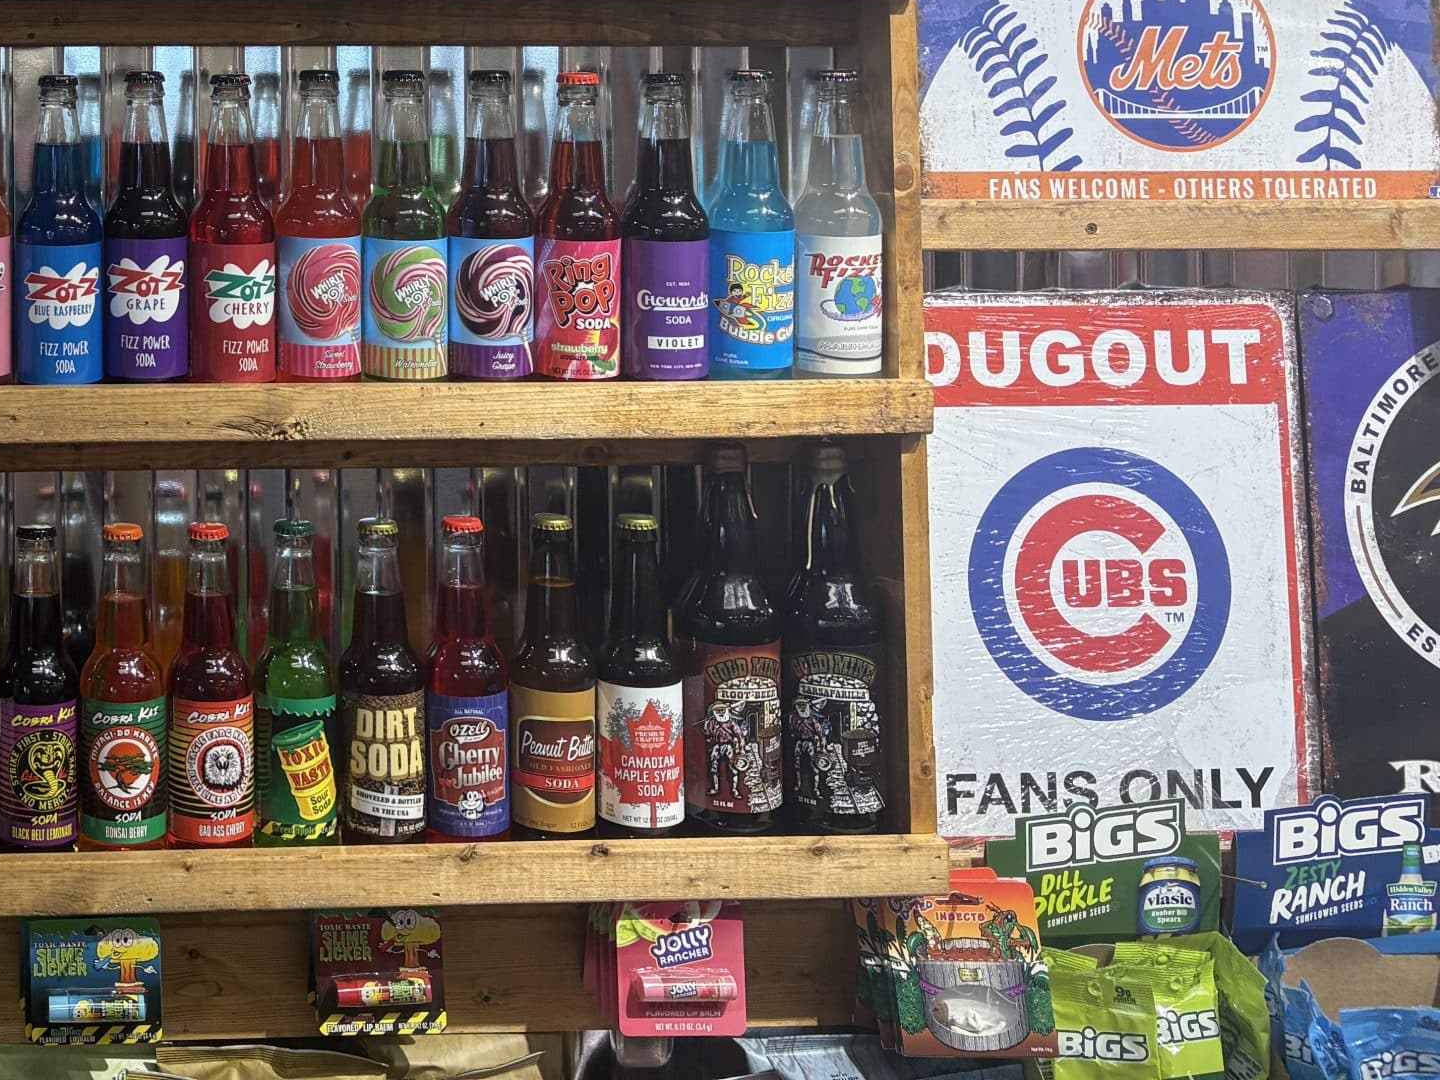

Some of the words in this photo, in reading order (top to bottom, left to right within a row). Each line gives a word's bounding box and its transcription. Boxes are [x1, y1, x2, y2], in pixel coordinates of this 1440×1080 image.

[1110, 26, 1243, 90] Mets
[989, 177, 1041, 200] FANS
[1049, 177, 1150, 200] WELCOME
[1174, 177, 1254, 199] OTHERS
[1263, 177, 1377, 199] TOLERATED
[542, 253, 611, 292] Ring
[310, 270, 344, 299] WHIRLY
[35, 305, 50, 315] BLUE
[54, 304, 92, 316] RASPBERRY
[127, 298, 165, 310] GRAPE
[224, 303, 269, 314] CHERRY
[576, 319, 611, 331] SODA
[665, 315, 692, 325] SODA
[720, 319, 772, 344] Bubble
[551, 343, 608, 355] strawberry
[656, 338, 701, 348] VIOLET
[395, 359, 438, 368] Watermelon
[923, 329, 1260, 387] DUGOUT
[1350, 352, 1440, 494] BALTIMORE
[283, 739, 326, 767] TOXIC
[522, 731, 563, 756] Peanut
[439, 742, 500, 769] Cherry
[621, 756, 674, 768] CANADIAN
[290, 758, 331, 788] WASTE
[454, 765, 502, 789] Jubilee
[545, 778, 580, 788] SODA
[615, 769, 651, 782] MAPLE
[654, 768, 679, 782] SYRUP
[311, 790, 329, 805] Sour
[638, 784, 664, 796] SODA
[947, 771, 1099, 815] FANS
[1120, 768, 1274, 807] ONLY
[312, 800, 331, 815] Soda
[105, 827, 128, 839] BONSAI
[130, 826, 148, 838] BERRY
[1041, 869, 1083, 896] DILL
[1284, 861, 1342, 891] ZESTY
[1146, 893, 1193, 907] vlasic
[1270, 870, 1366, 924] RANCH
[1390, 897, 1433, 911] Ranch
[1047, 909, 1087, 927] SUNFLOWER
[1089, 904, 1111, 916] SEEDS
[1295, 904, 1339, 925] SUNFLOWER
[1341, 899, 1363, 912] SEEDS
[655, 925, 709, 955] JOLLY
[659, 945, 709, 966] RANCHER
